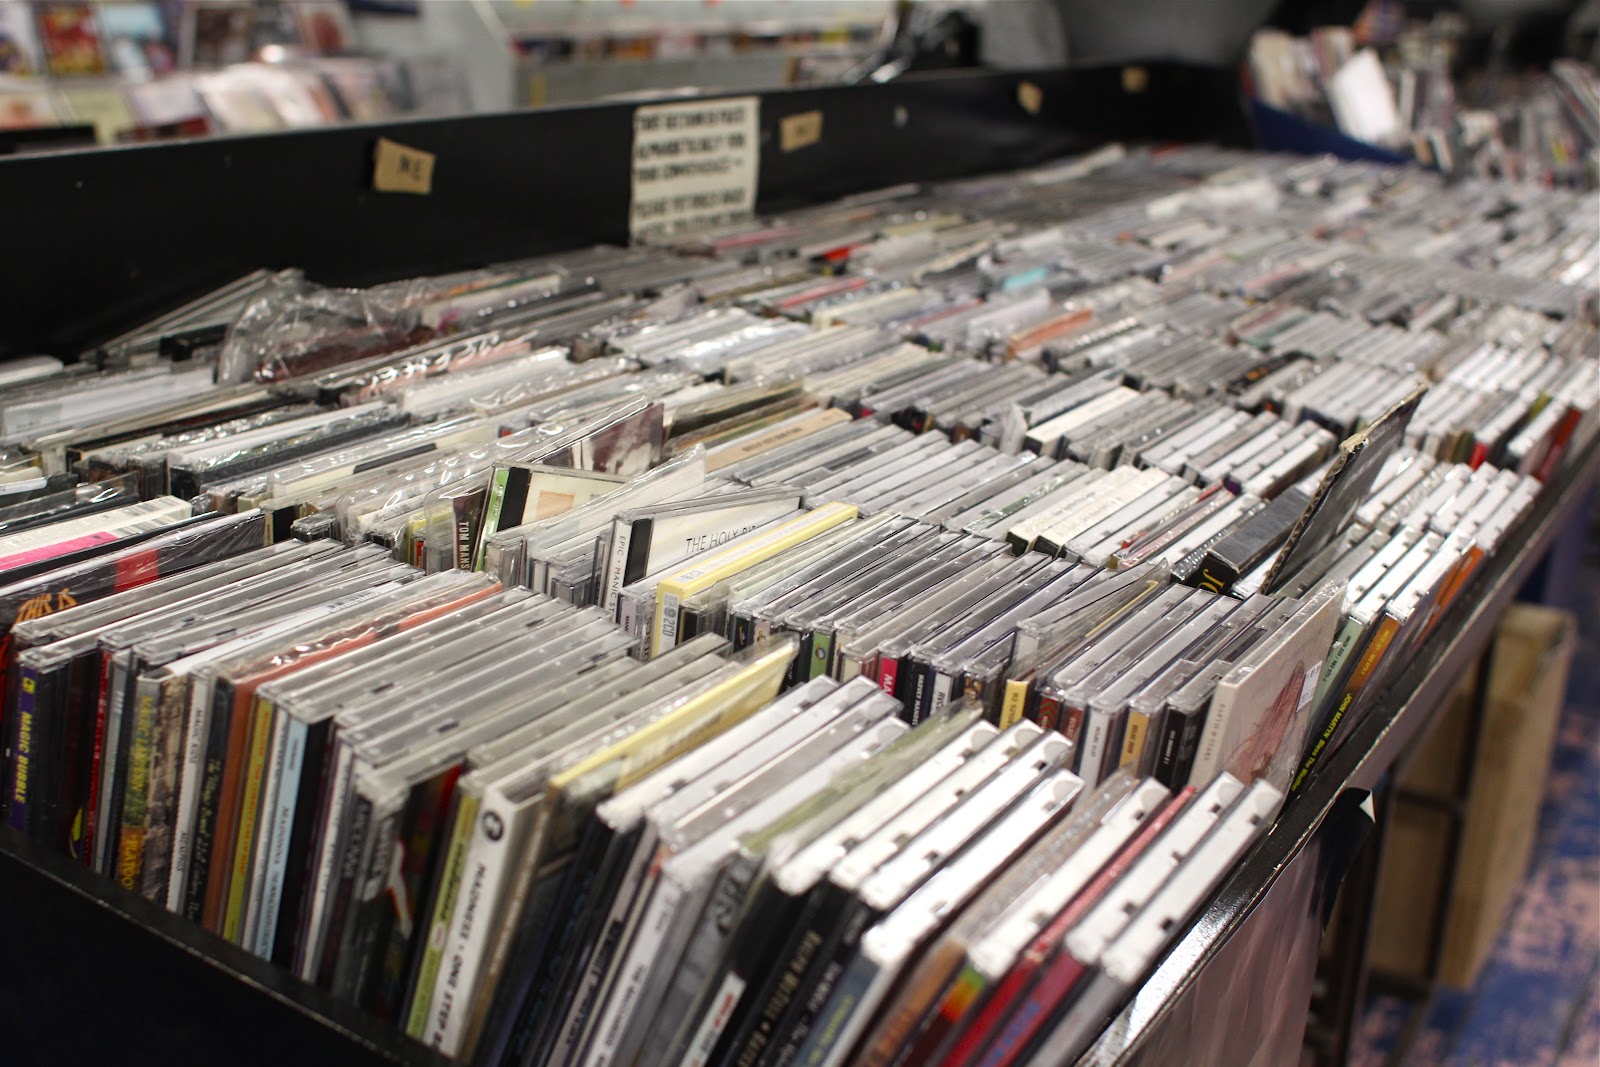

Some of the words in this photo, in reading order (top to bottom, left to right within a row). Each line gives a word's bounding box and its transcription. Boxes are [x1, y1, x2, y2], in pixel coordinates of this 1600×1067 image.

[458, 521, 469, 542] TOM
[686, 534, 707, 554] THE
[616, 535, 626, 557] EPIC
[610, 566, 622, 598] MANIC
[662, 617, 674, 637] 2CD
[916, 674, 925, 699] HARVEY
[912, 699, 922, 726] MANDEL
[1338, 692, 1353, 712] JOHN
[19, 711, 32, 754] MAGIC
[192, 708, 204, 738] MAGIC
[1322, 710, 1342, 738] MARTYN
[1310, 738, 1326, 758] Bless
[1303, 755, 1315, 769] The
[15, 755, 29, 804] BUBBLE
[1289, 766, 1308, 793] Weather
[176, 832, 189, 873] MEMPHIS
[460, 863, 487, 941] MADNESS
[447, 953, 464, 989] ONE
[438, 991, 454, 1031] STEP
